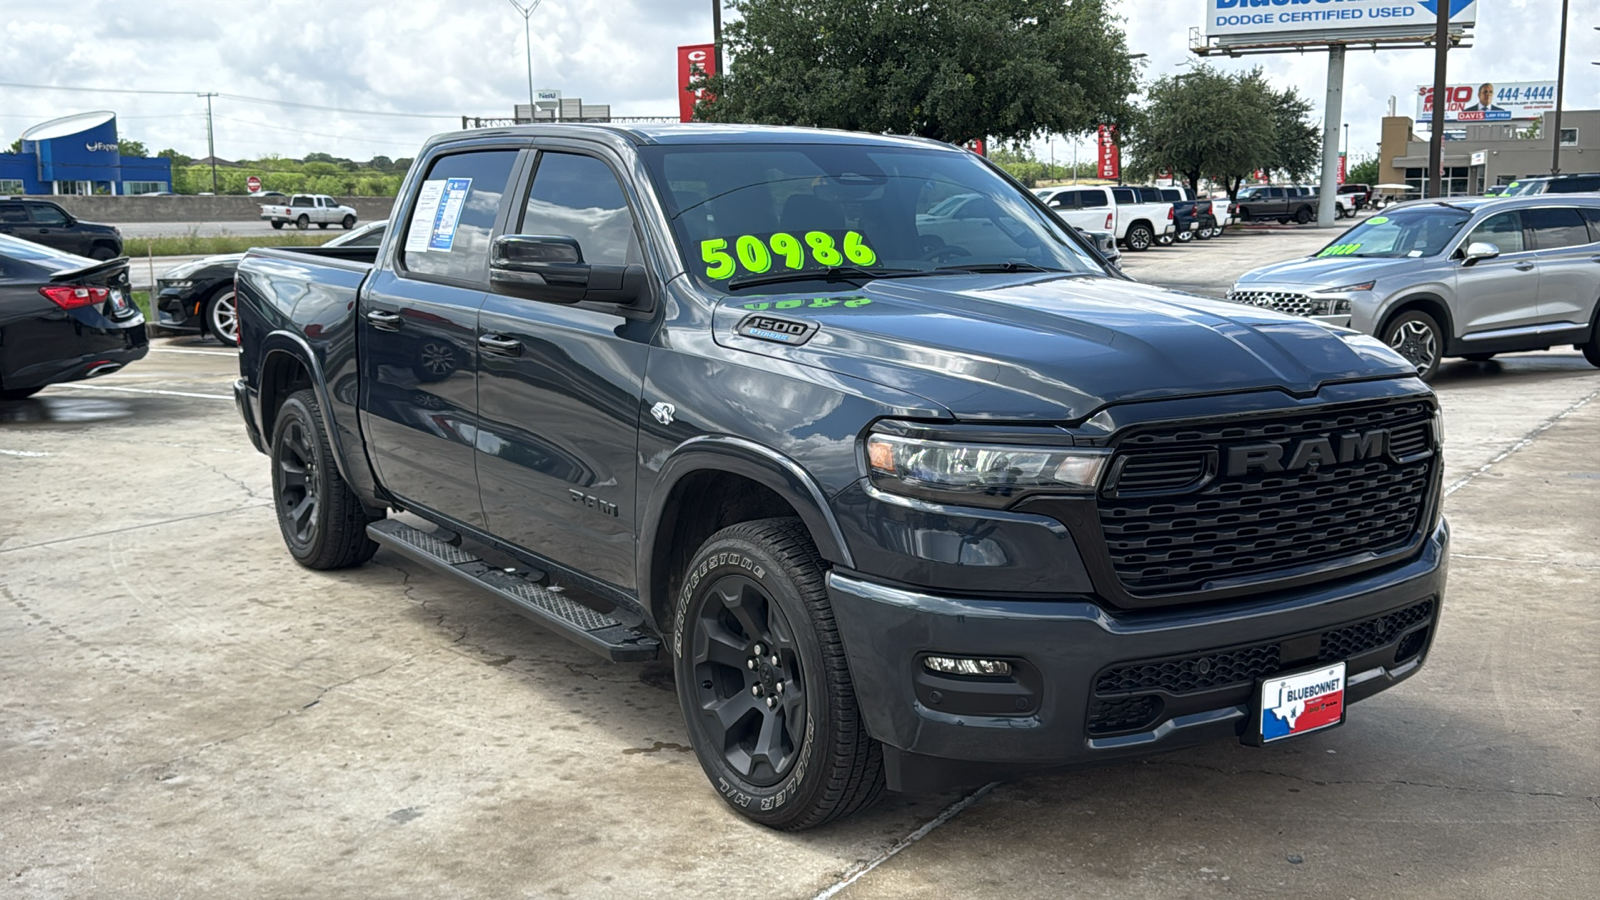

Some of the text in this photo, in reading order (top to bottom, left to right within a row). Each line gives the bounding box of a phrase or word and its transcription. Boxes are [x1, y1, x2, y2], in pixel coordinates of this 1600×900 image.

[1216, 6, 1415, 26] DODGE CERTIFIED USED
[1497, 86, 1554, 101] 444-4444
[1422, 102, 1466, 112] MION
[1459, 112, 1484, 120] DAVIS
[701, 231, 877, 280] 50986
[752, 318, 805, 335] 1500
[1227, 429, 1385, 477] RAM
[569, 488, 619, 517] RAM
[675, 553, 766, 658] BRIDGESTONE
[1287, 678, 1341, 702] BLUEBONNET
[719, 712, 815, 811] DUELER H/L
